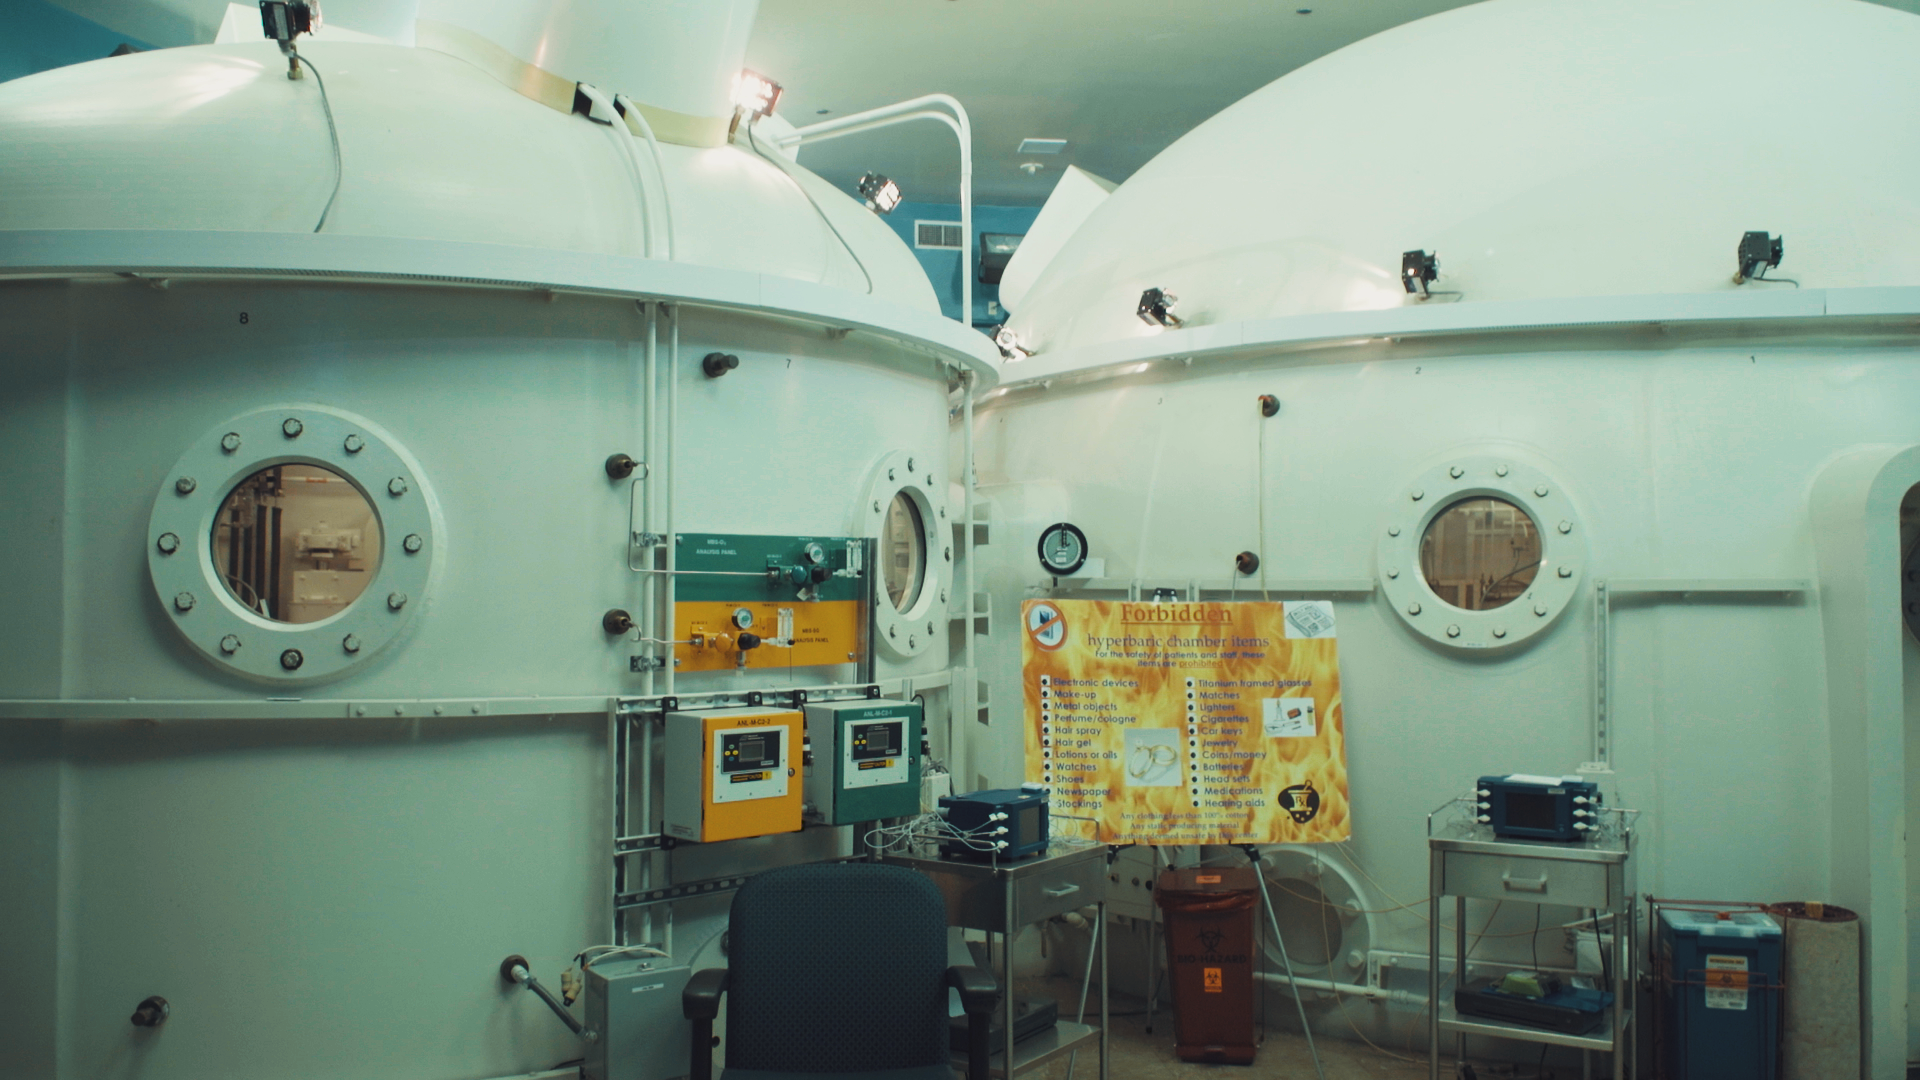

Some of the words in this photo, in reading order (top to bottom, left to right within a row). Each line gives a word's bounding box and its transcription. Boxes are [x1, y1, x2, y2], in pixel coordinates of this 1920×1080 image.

[239, 312, 249, 324] 8
[786, 358, 792, 369] 7
[1415, 366, 1421, 374] 2
[1121, 604, 1232, 623] Forbidden
[1088, 634, 1162, 650] hyperbaric
[1167, 635, 1227, 648] chamber
[1231, 635, 1270, 648] items
[1126, 651, 1150, 659] safety
[1164, 651, 1198, 659] patients
[1179, 660, 1223, 669] prohibited
[1053, 678, 1099, 687] Electronic
[1102, 679, 1139, 687] devices
[1198, 680, 1238, 688] Titanium
[1240, 680, 1274, 688] framed
[1277, 680, 1312, 689] glasses
[1053, 691, 1097, 700] Make-up
[1199, 691, 1240, 700] Matches
[1053, 702, 1081, 711] Metal
[1083, 702, 1118, 713] objects
[1200, 703, 1236, 713] Lighters
[1054, 714, 1137, 725] Perfume/cologne
[1200, 714, 1250, 725] Cigarettes
[1055, 726, 1073, 735] Hair
[1076, 727, 1102, 737] spray
[1201, 727, 1219, 735] Car
[1221, 727, 1243, 737] keys
[1055, 738, 1074, 747] Hair
[1076, 738, 1092, 749] gel
[1201, 739, 1238, 749] Jewelry
[1055, 750, 1088, 759] Lotions
[1102, 750, 1118, 759] oils
[1202, 750, 1267, 760] Coins/money
[1056, 763, 1097, 772] Watches
[1203, 762, 1245, 772] Batteries
[1056, 774, 1085, 783] Shoes
[1203, 775, 1230, 783] Head
[1232, 775, 1251, 783] sets
[1057, 787, 1112, 797] Newspaper
[1204, 786, 1264, 796] Medications
[1057, 799, 1103, 810] Stockings
[1204, 799, 1243, 809] Hearing
[1245, 799, 1266, 808] aids
